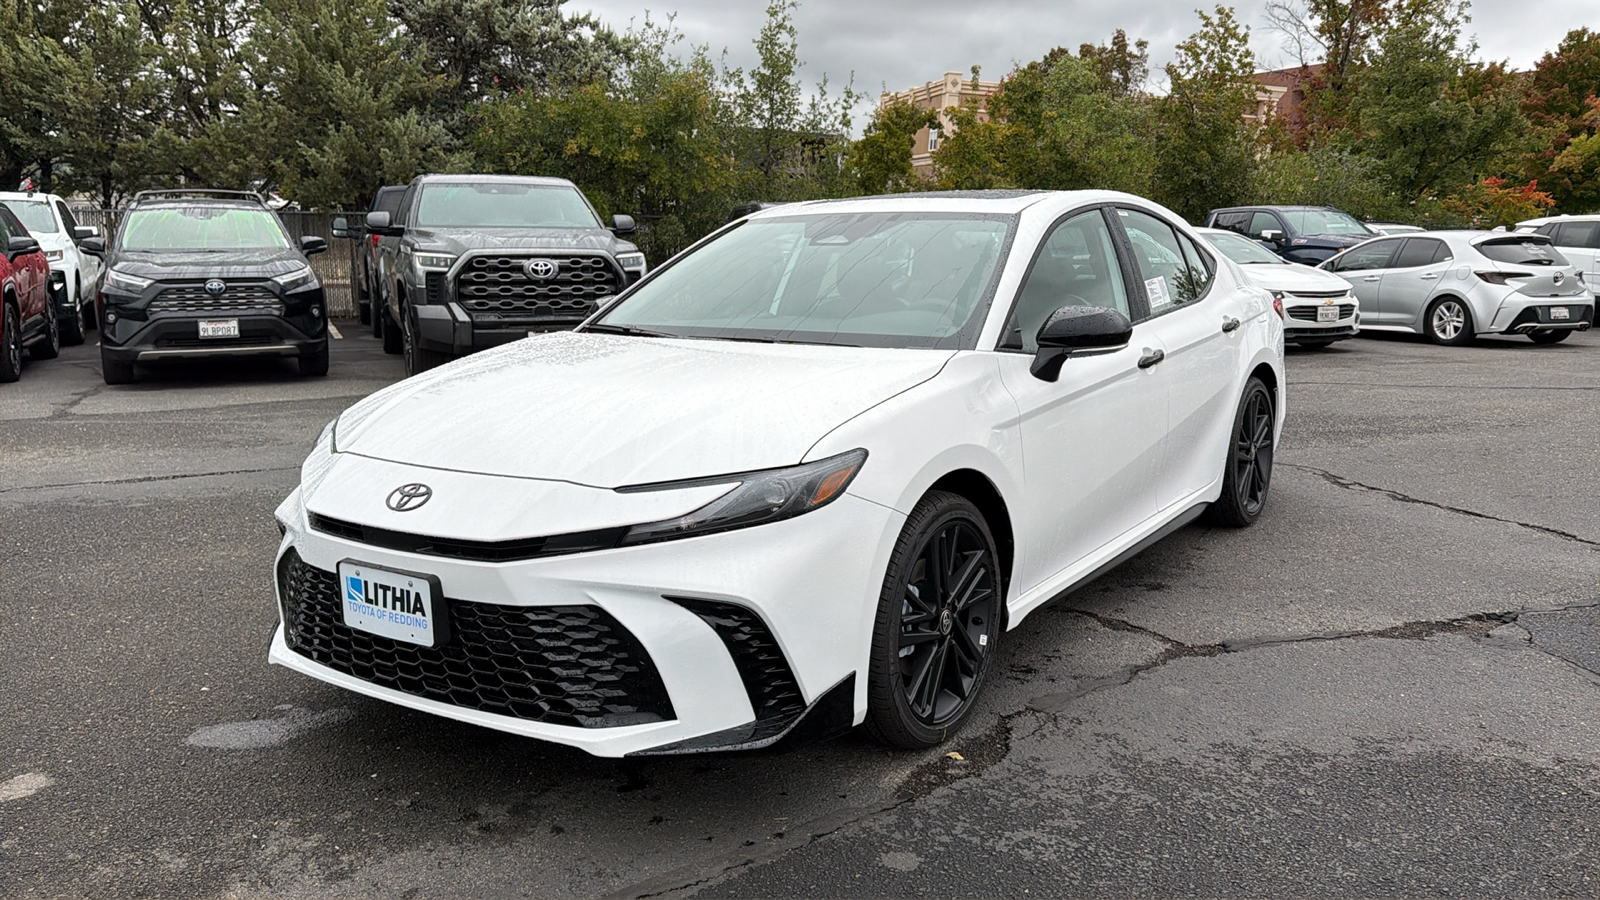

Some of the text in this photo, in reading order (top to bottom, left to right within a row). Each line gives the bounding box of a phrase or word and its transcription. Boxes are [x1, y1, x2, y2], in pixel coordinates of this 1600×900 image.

[363, 580, 427, 617] LITHIA
[348, 601, 428, 629] TOYOTA OF REDDING
